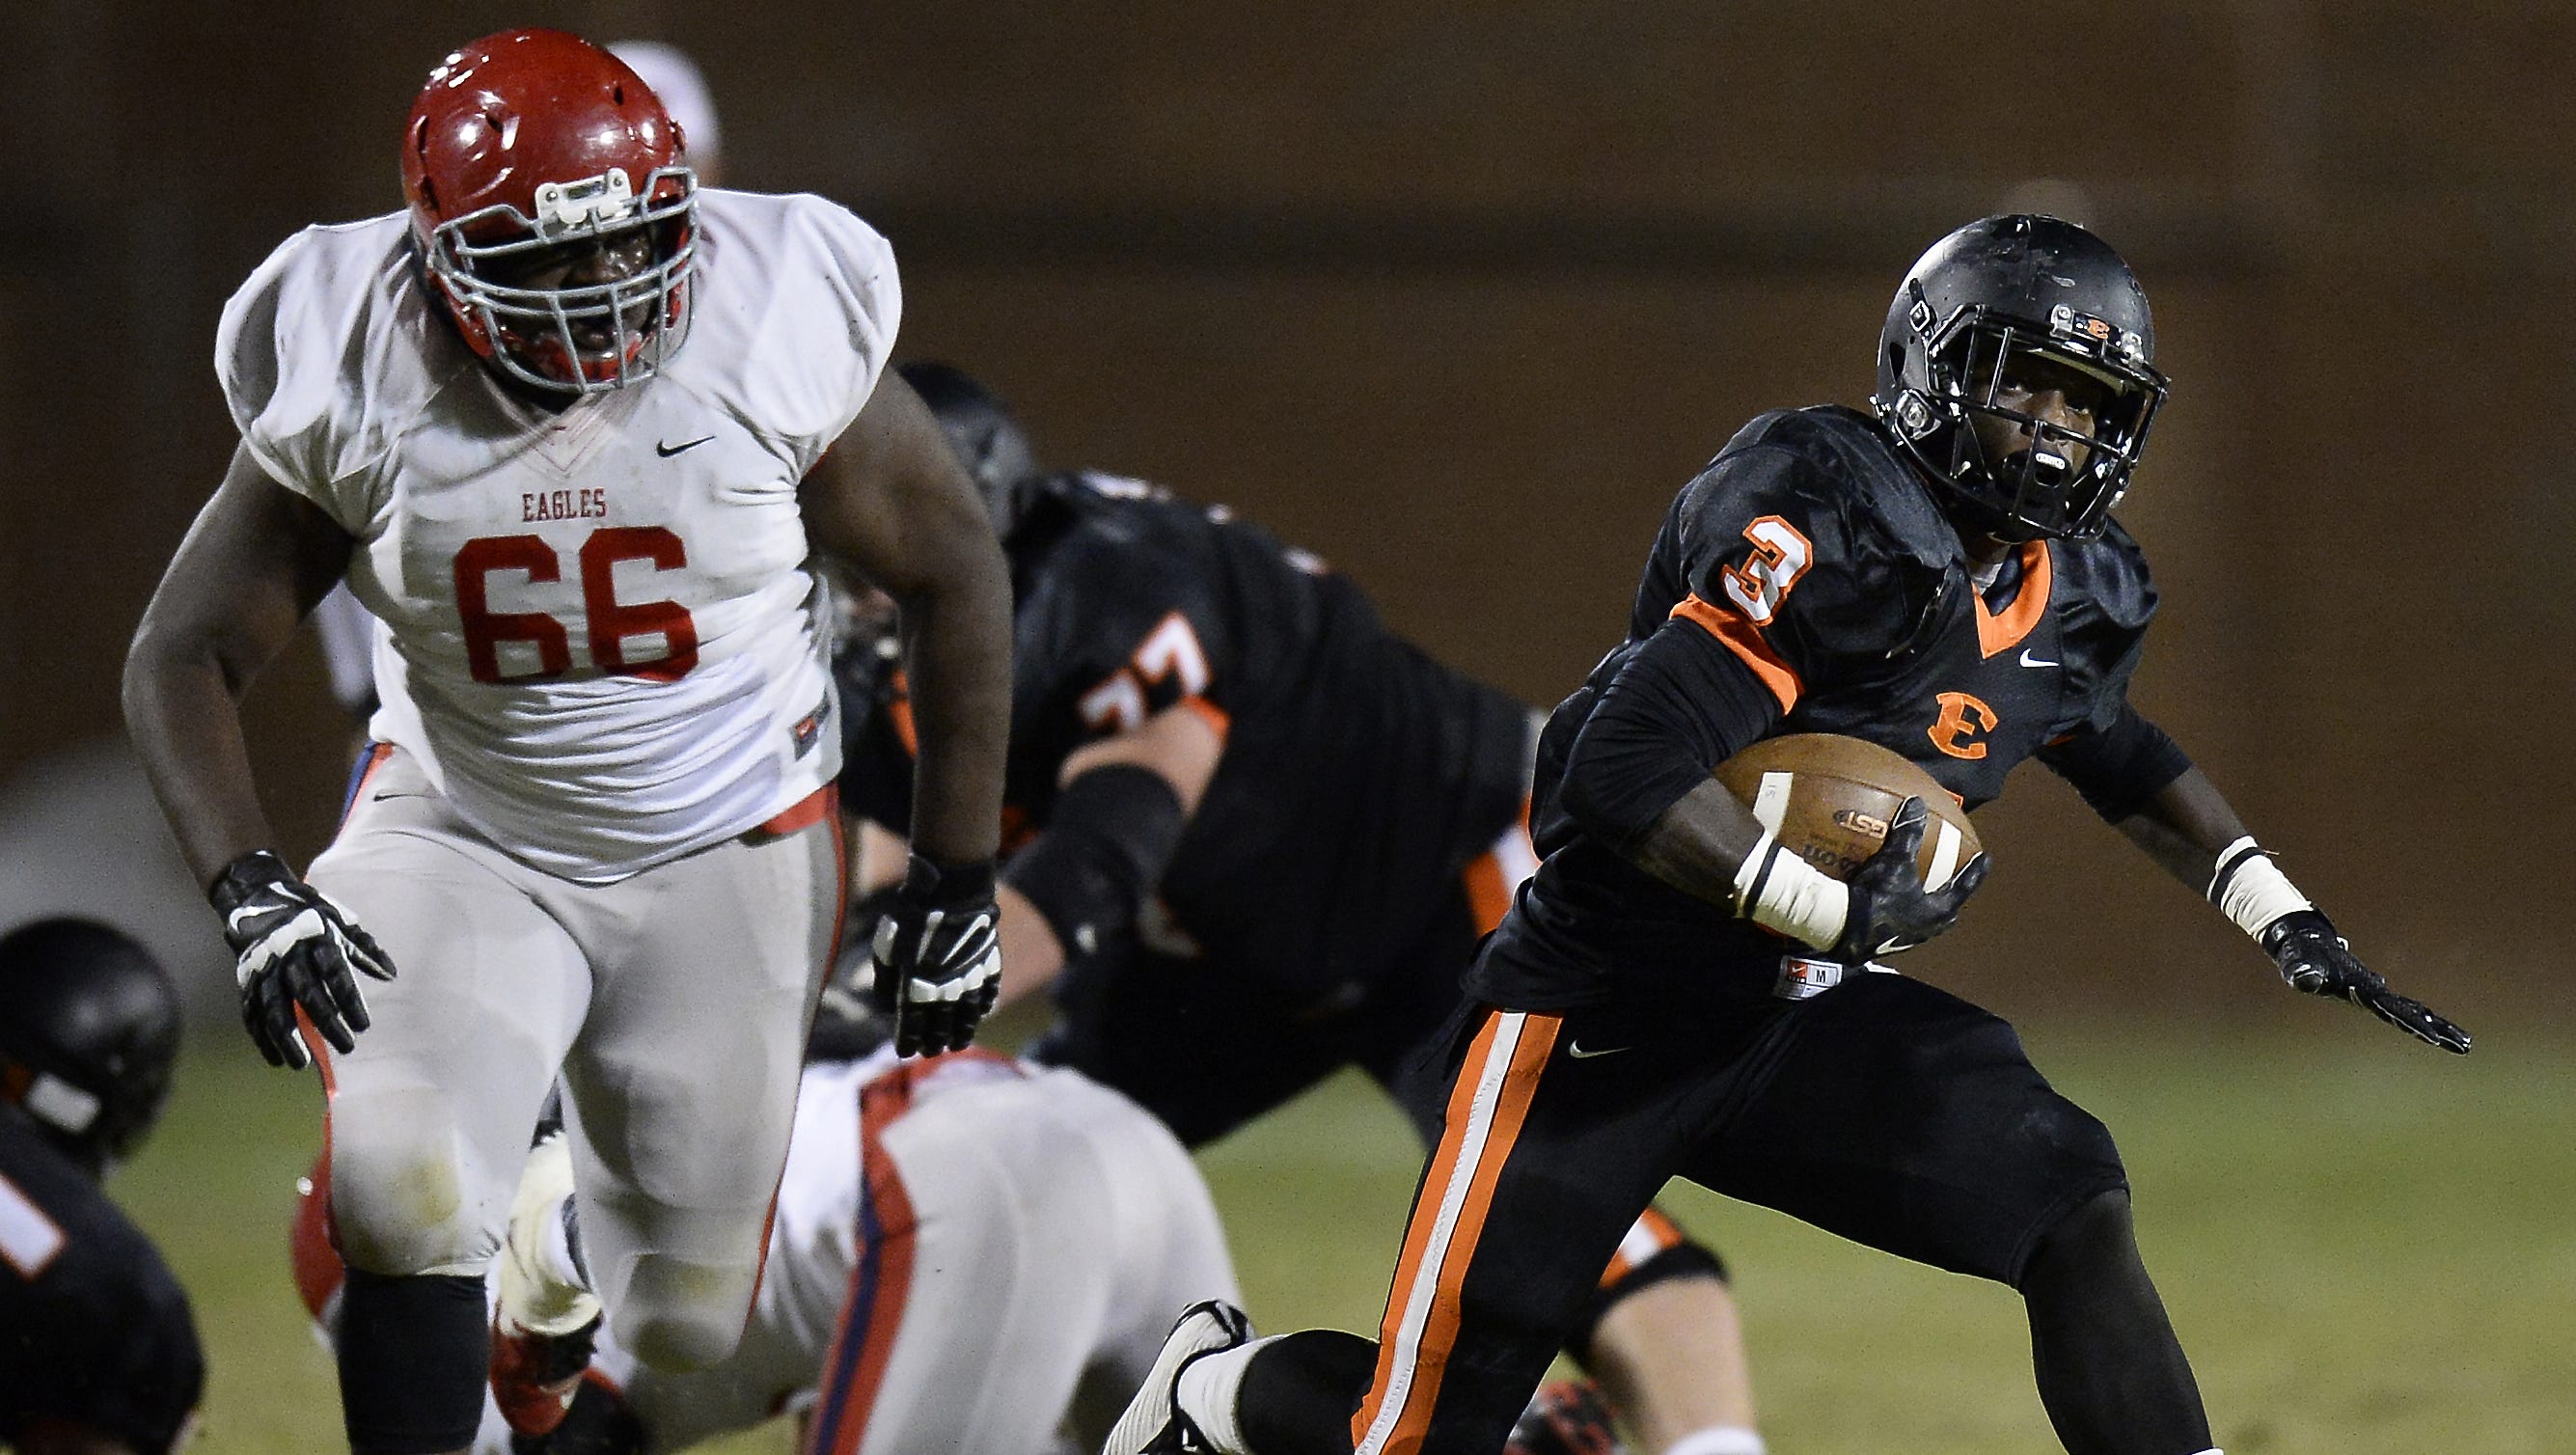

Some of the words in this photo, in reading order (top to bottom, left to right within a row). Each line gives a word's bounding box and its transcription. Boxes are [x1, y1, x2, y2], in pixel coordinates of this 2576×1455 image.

[522, 488, 606, 522] EAGLES
[1721, 514, 1814, 627] 3
[453, 526, 699, 685] 66
[1928, 691, 1998, 759] E
[1816, 970, 1826, 983] M
